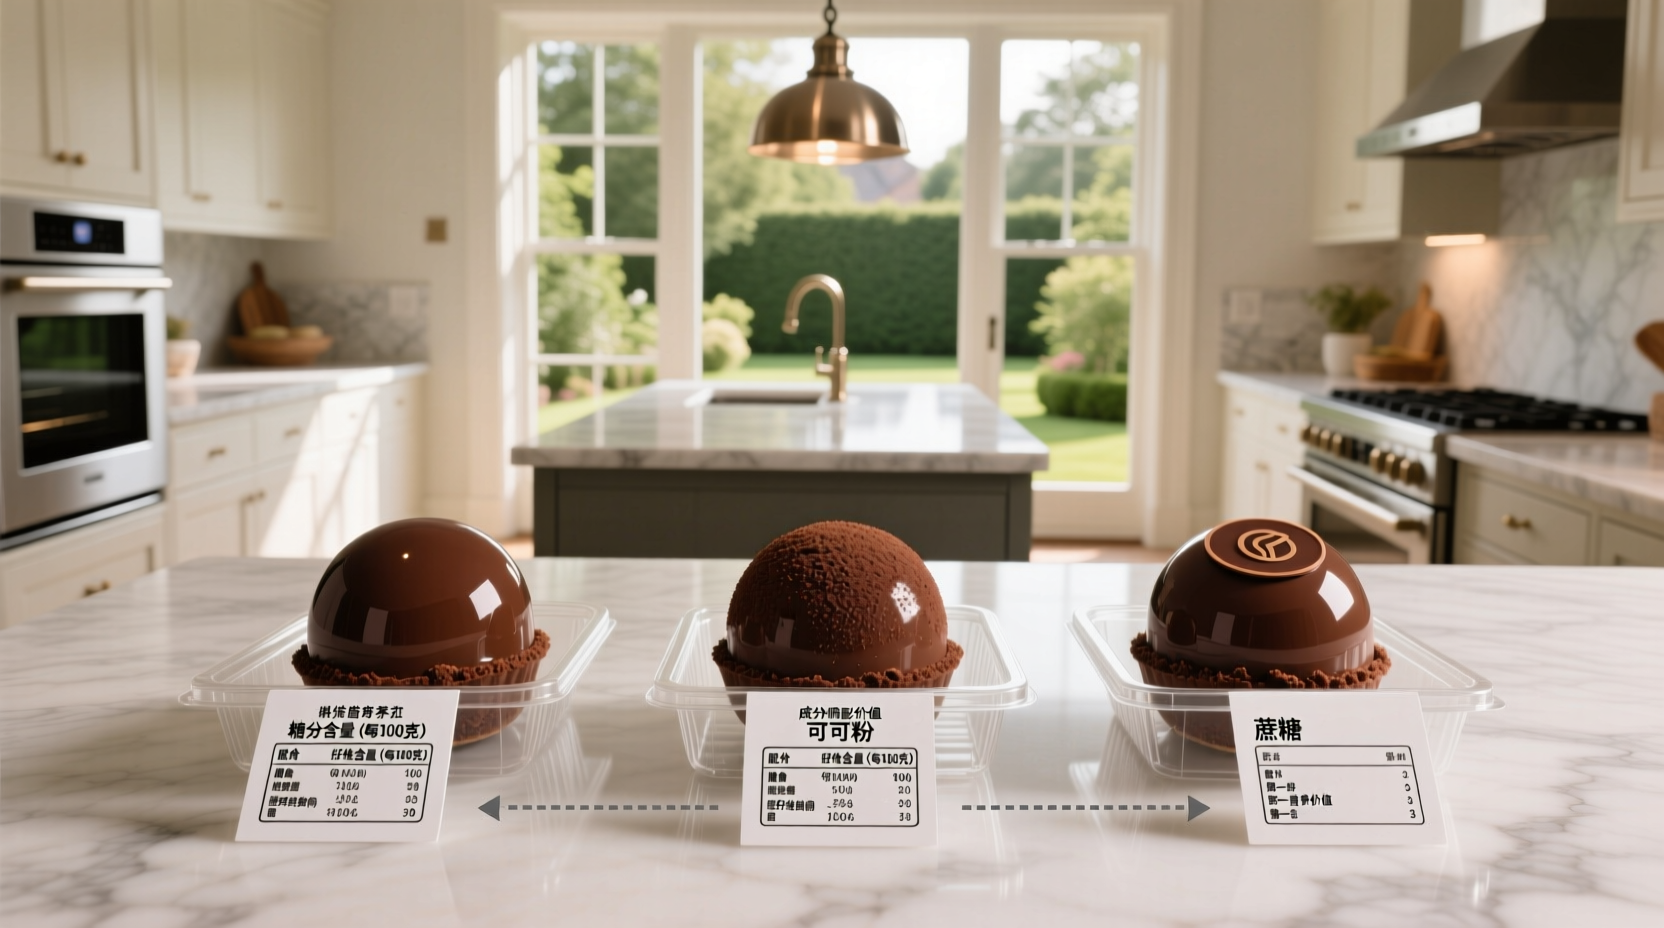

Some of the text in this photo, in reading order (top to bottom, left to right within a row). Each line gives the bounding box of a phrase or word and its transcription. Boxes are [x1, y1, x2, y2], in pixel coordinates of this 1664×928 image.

[807, 721, 874, 742] 可可粉
[1254, 717, 1302, 741] 蔗糖
